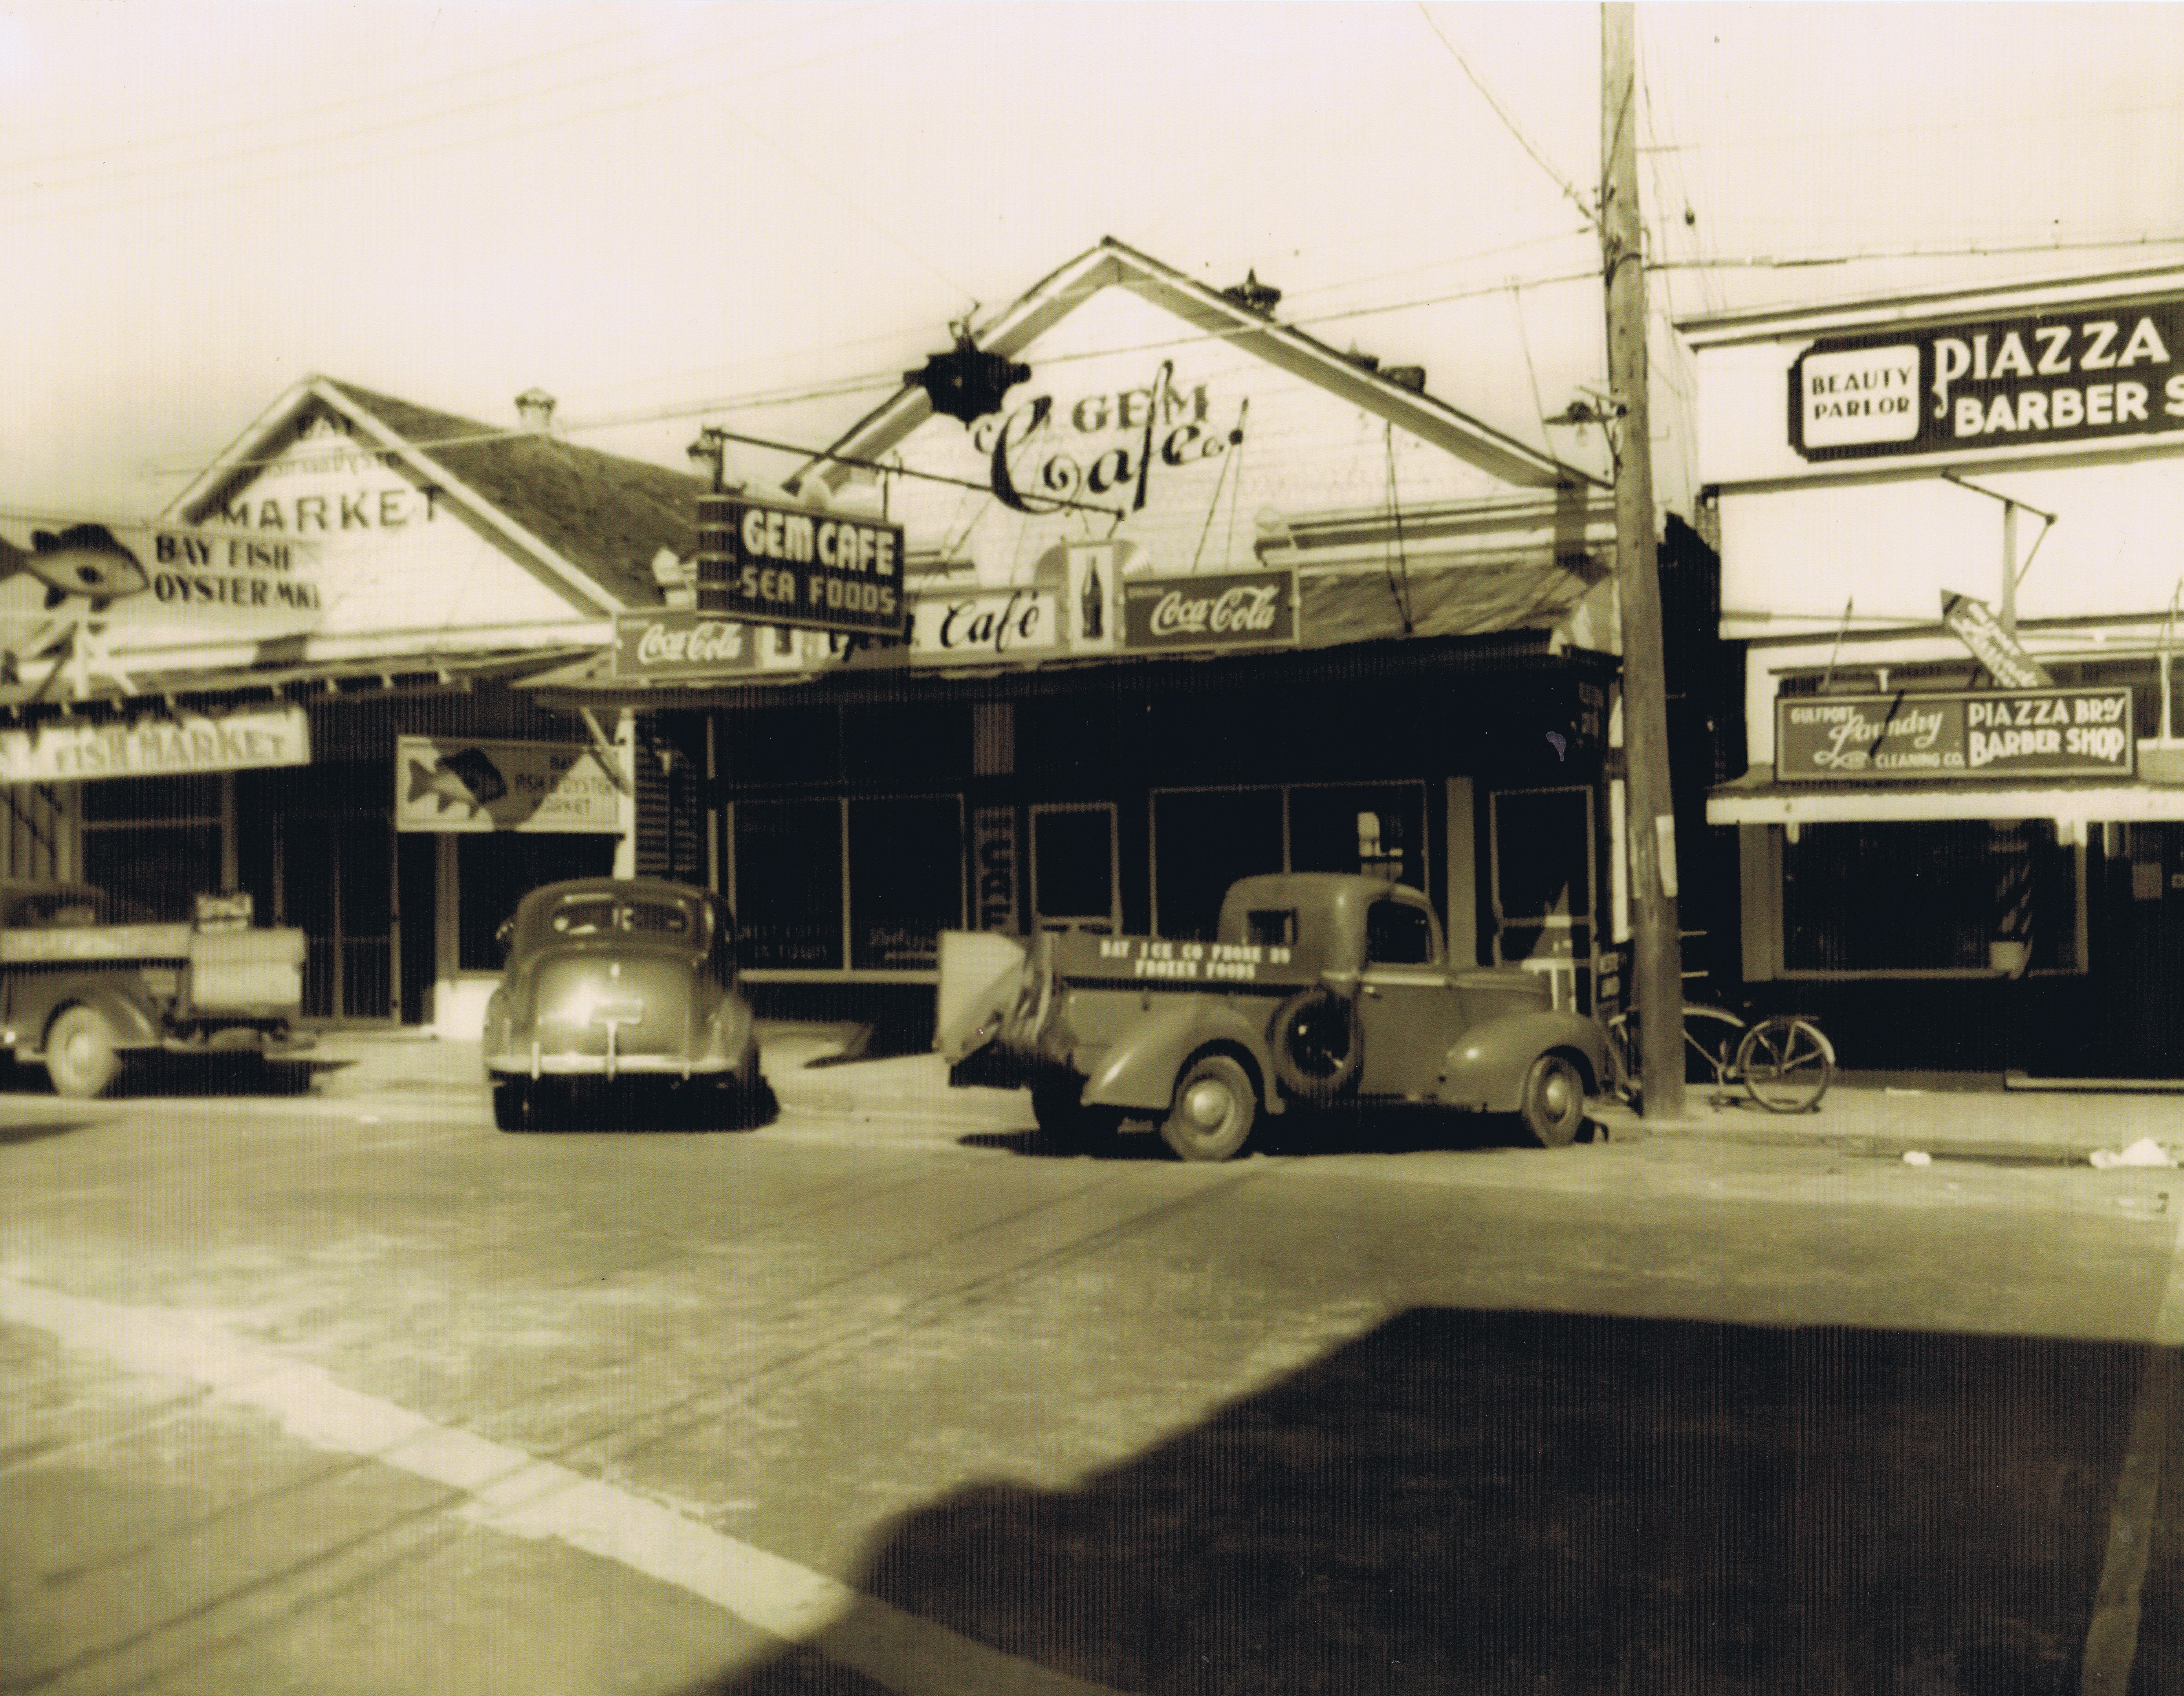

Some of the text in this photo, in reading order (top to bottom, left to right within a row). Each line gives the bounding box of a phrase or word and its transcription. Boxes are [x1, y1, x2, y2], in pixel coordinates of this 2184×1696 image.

[1812, 367, 1912, 396] BEAUTY
[1932, 316, 2171, 419] PIAZZA
[1072, 383, 1209, 434] GEM
[1814, 395, 1910, 420] PARLOR
[1954, 382, 2149, 438] BARBER
[220, 484, 446, 532] MARKET
[155, 534, 290, 572] BAY FISH
[742, 509, 896, 576] GEM CAFE
[154, 574, 268, 608] OYSTER
[741, 565, 897, 616] SEA FOODS
[1151, 584, 1280, 636] Coca-Cola
[1969, 698, 2070, 727] PIAZZA
[138, 728, 286, 767] MARKET
[1969, 727, 2125, 767] BARBER SHOP
